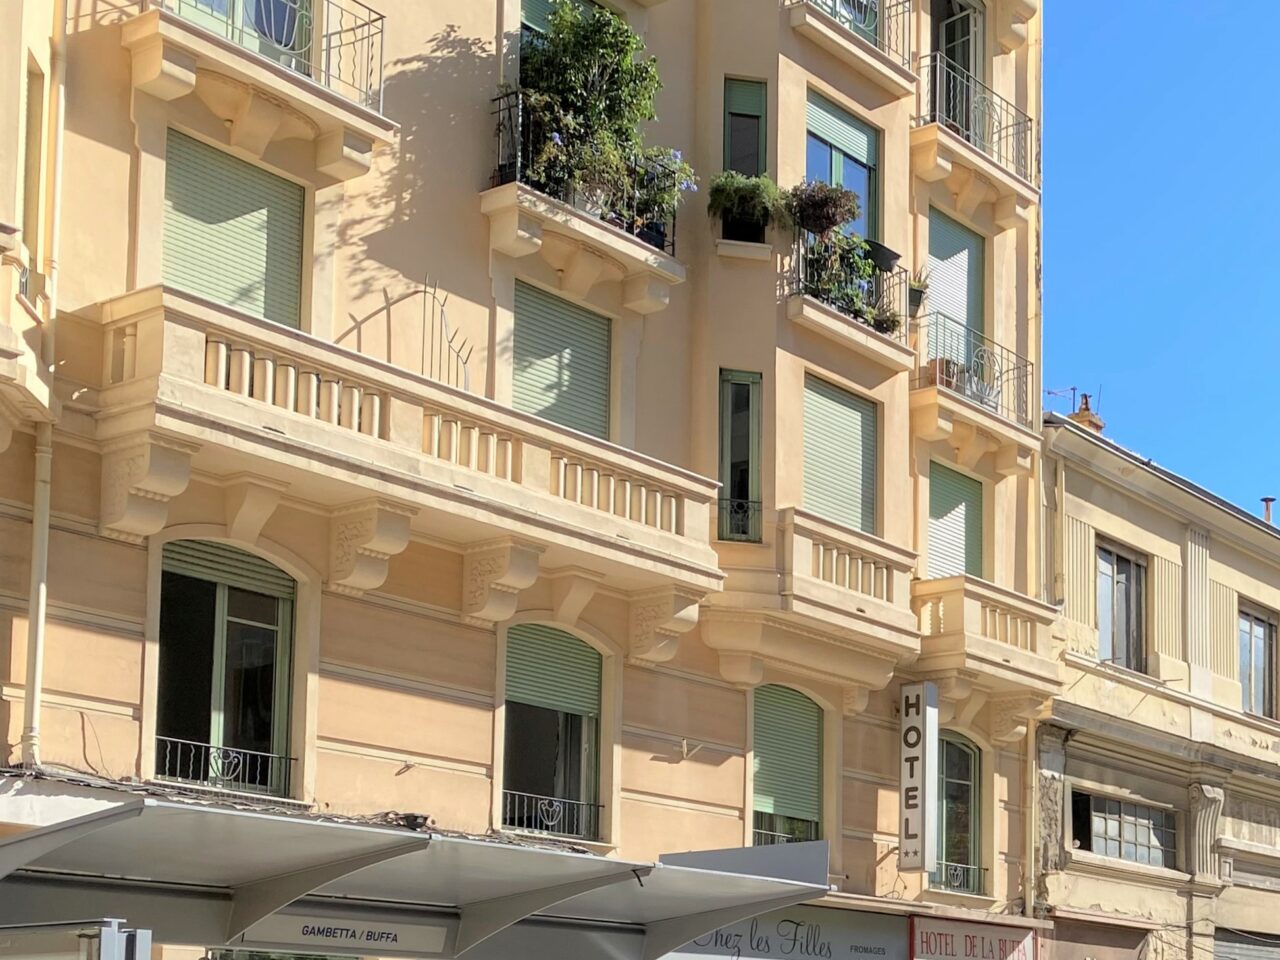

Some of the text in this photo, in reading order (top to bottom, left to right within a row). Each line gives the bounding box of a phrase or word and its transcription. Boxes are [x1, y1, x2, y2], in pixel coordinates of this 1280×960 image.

[903, 693, 921, 840] HOTEL
[302, 925, 357, 940] GAMBETTA
[365, 930, 398, 943] BUFFA
[750, 918, 770, 954] les
[776, 919, 832, 960] Filles
[920, 931, 957, 957] HOTEL
[964, 934, 978, 958] DE
[981, 937, 995, 960] LA
[850, 944, 886, 956] FROMAGES
